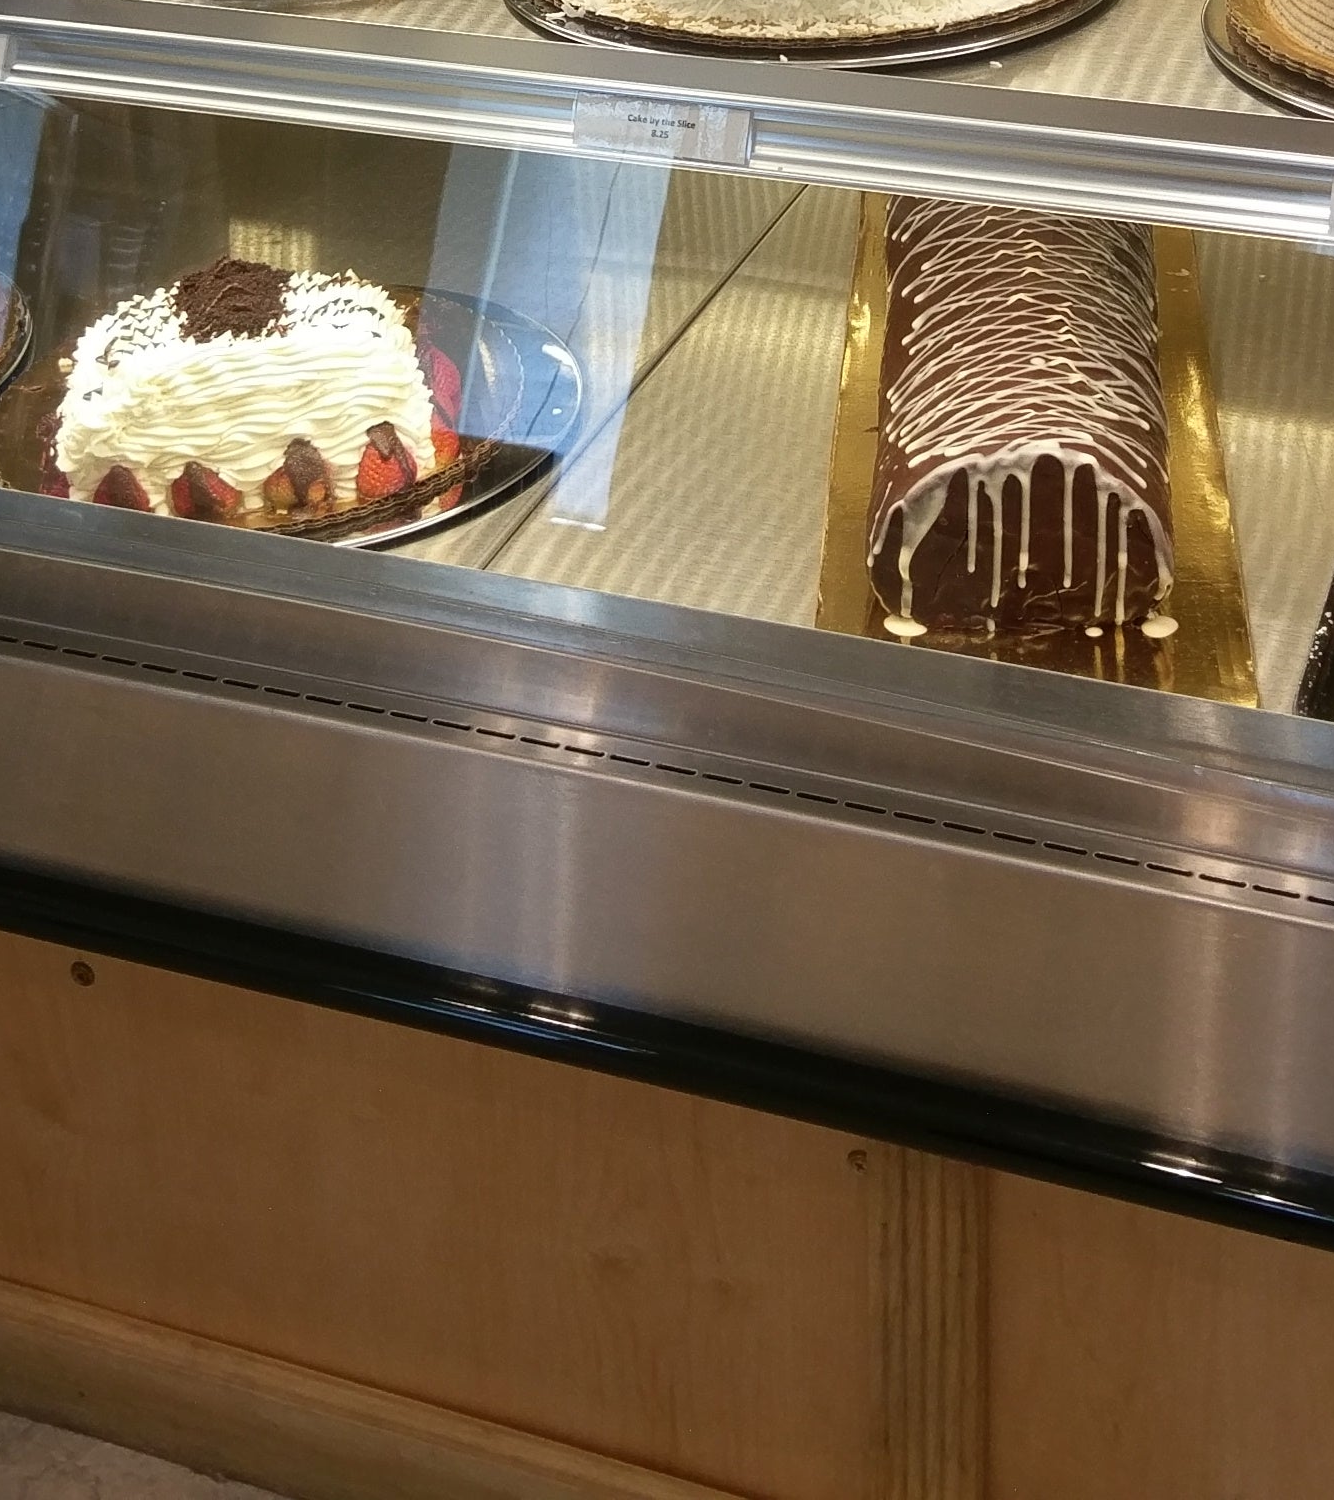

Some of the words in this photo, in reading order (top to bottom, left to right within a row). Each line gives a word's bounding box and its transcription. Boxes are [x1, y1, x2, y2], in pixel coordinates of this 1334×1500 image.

[627, 114, 648, 124] Cake
[649, 115, 660, 127] by
[662, 117, 675, 127] the
[677, 119, 696, 130] Slice
[651, 129, 669, 139] 8.25
